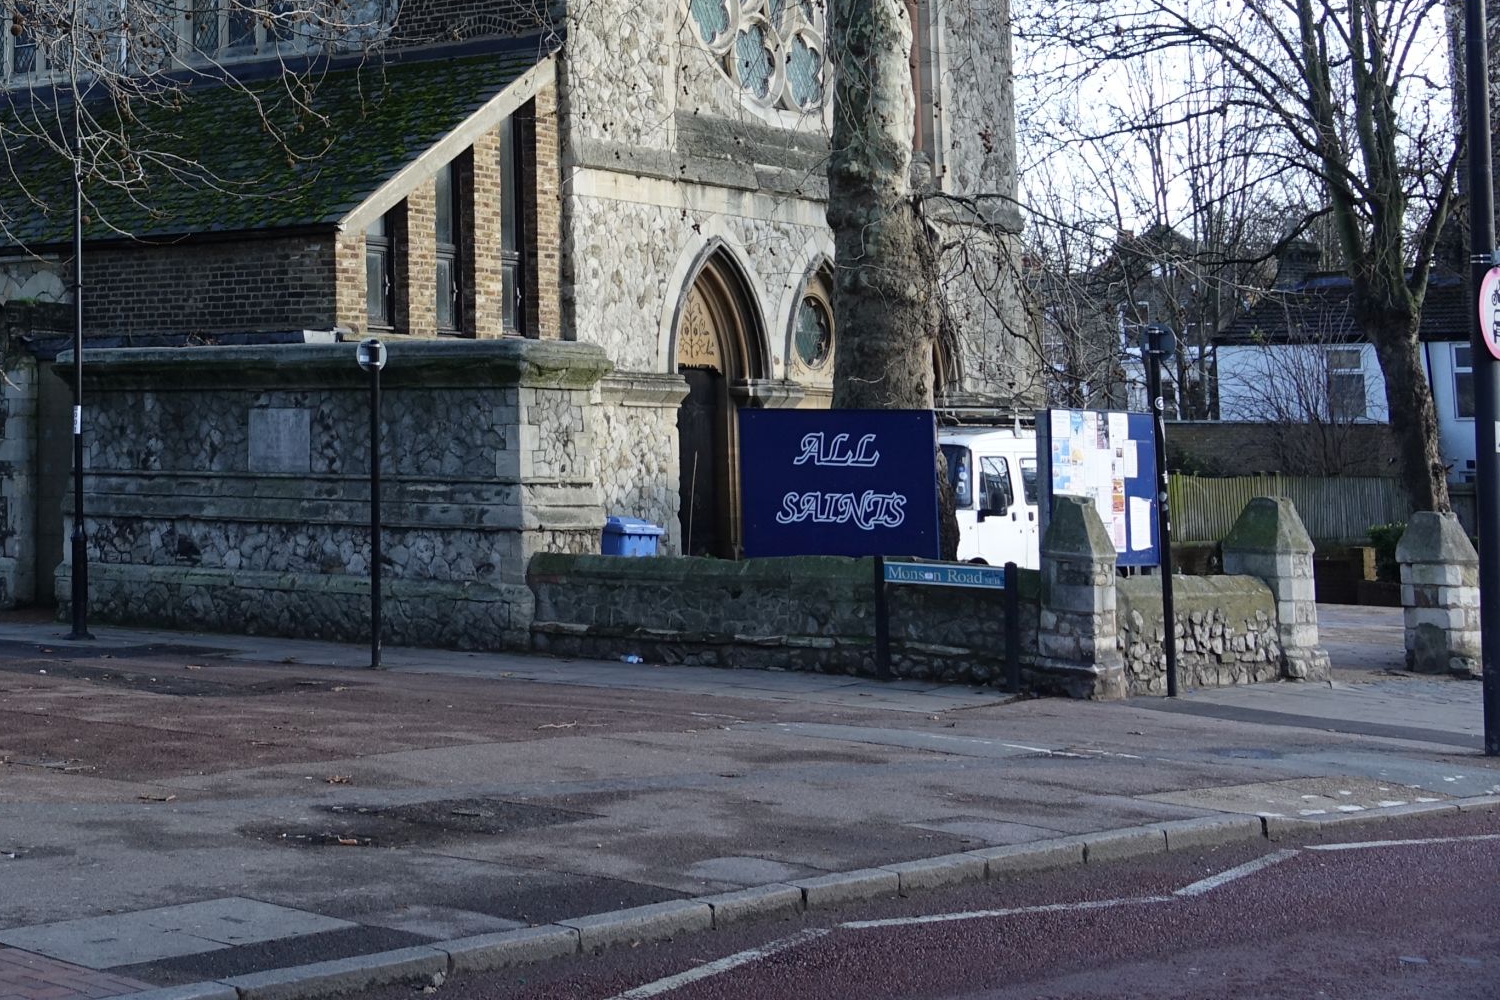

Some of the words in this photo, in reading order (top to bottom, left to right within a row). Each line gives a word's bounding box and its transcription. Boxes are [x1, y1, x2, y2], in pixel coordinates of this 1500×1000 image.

[793, 431, 880, 467] ALL
[776, 490, 907, 530] SAINTS
[888, 566, 942, 581] Monsn
[947, 569, 982, 584] Road
